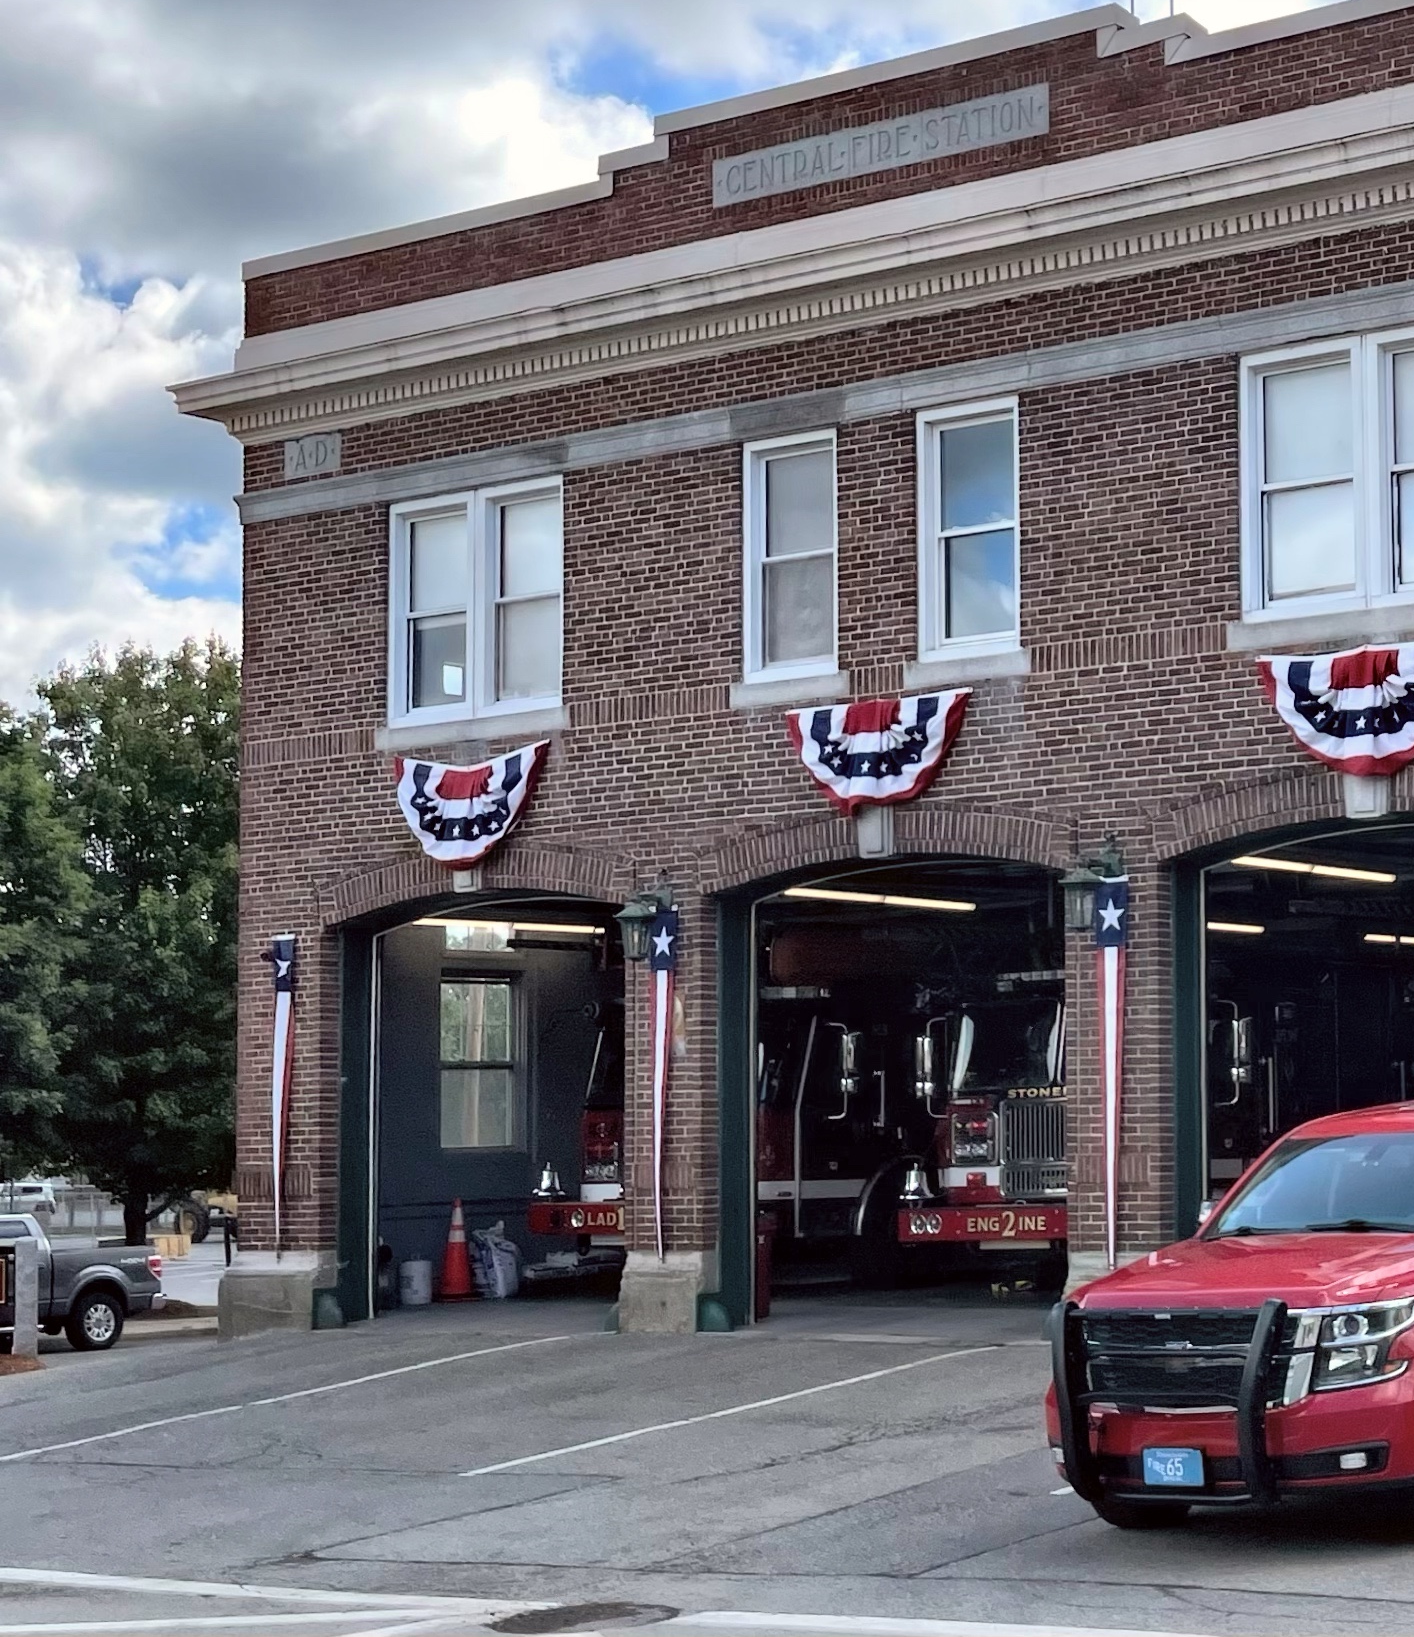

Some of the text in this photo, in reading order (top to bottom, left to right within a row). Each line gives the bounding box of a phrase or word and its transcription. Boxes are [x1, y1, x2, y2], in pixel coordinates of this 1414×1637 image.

[725, 96, 1035, 197] CENTRAL FIRE STATION
[1007, 1086, 1067, 1099] STONE
[1147, 1457, 1184, 1477] FIRE 65
